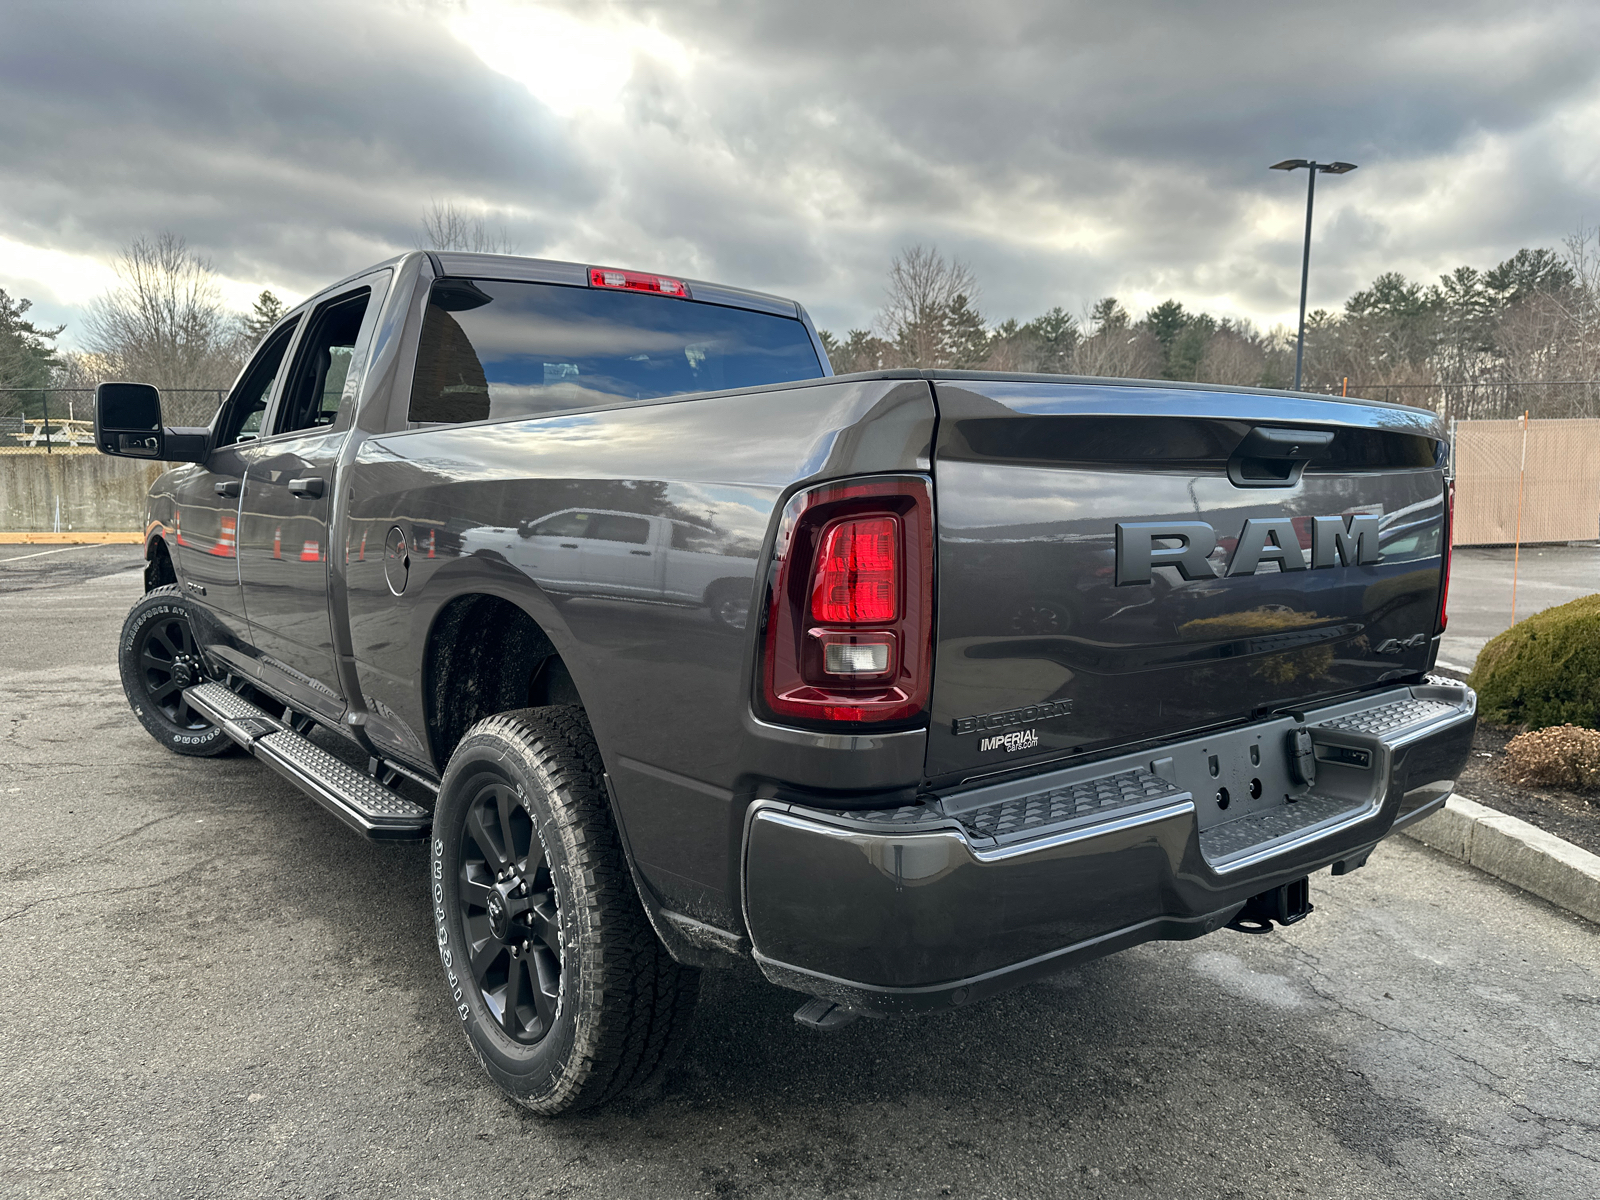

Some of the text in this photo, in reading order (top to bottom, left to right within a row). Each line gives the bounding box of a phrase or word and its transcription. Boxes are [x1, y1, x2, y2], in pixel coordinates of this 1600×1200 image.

[1114, 514, 1384, 587] RAM
[126, 605, 170, 651] TRANSFORCE
[980, 729, 1039, 752] IMPERIAL
[1006, 739, 1038, 753] cars.com
[434, 838, 470, 1021] Firestone
